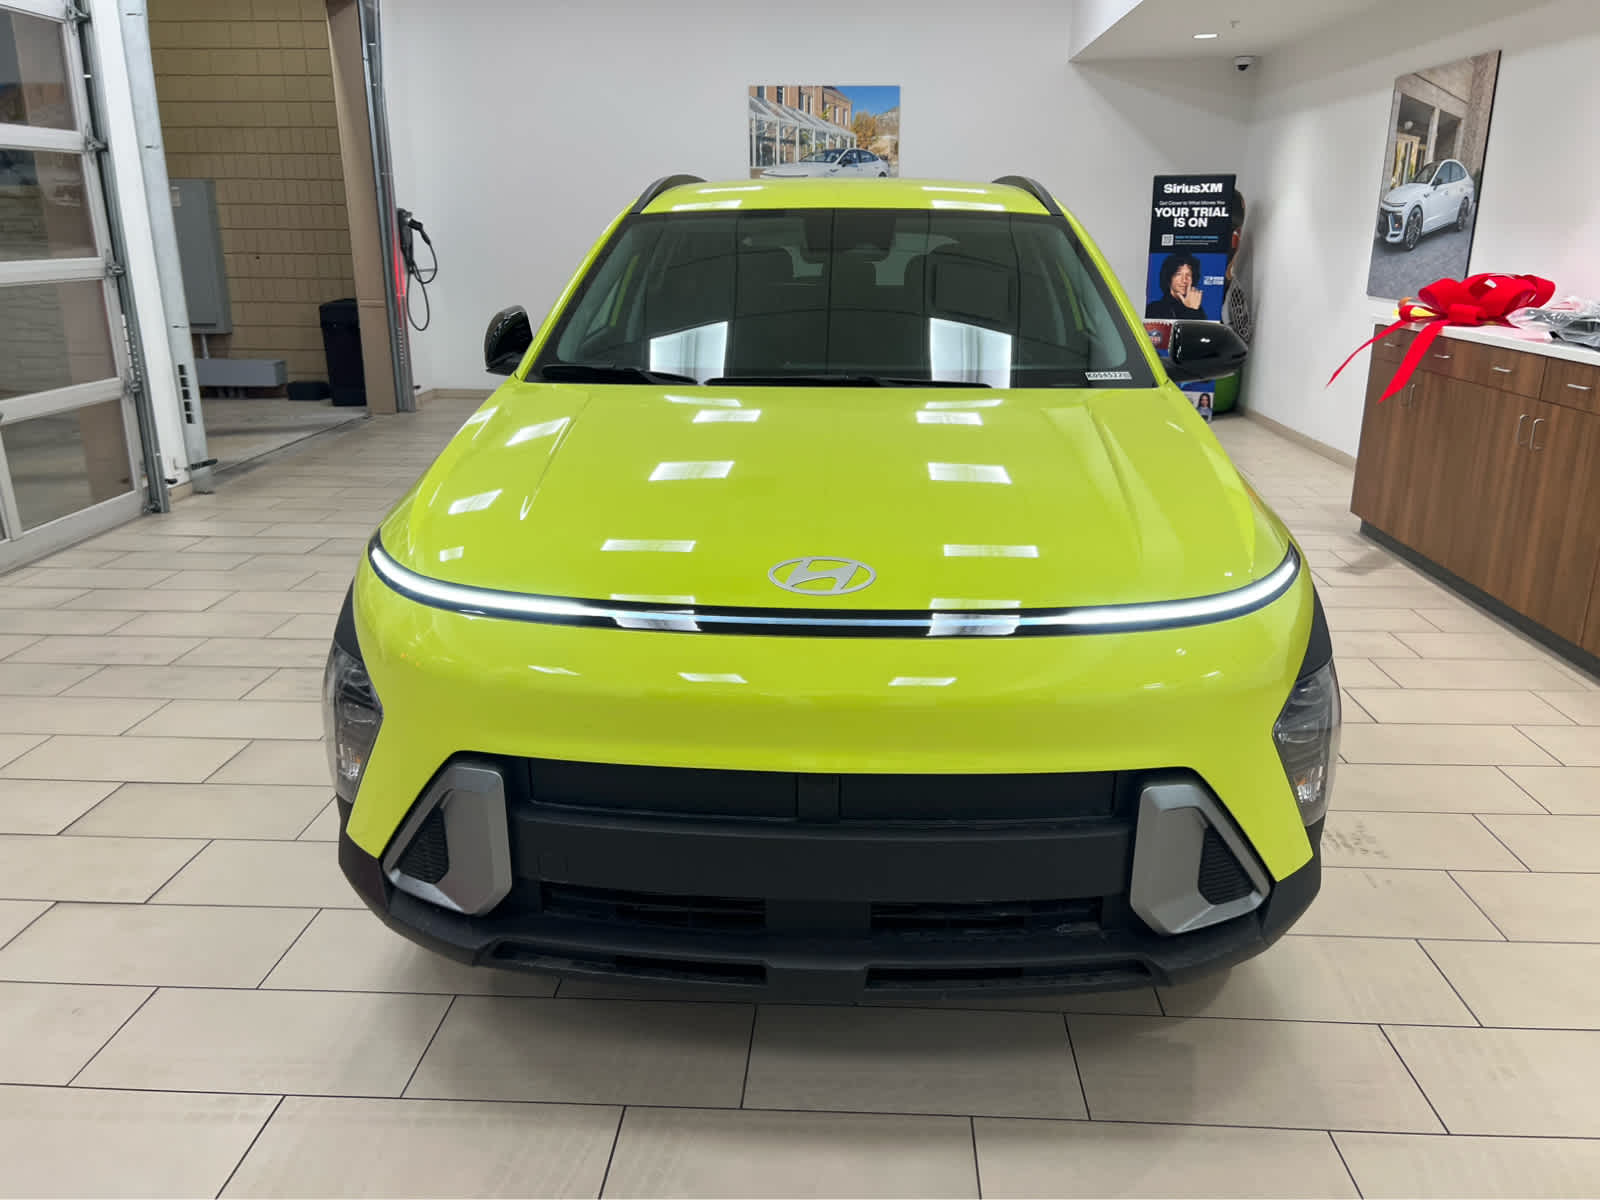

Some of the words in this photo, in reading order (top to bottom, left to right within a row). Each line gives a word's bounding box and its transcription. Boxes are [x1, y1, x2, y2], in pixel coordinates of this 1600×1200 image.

[1163, 182, 1223, 194] SiriusXM
[1154, 207, 1189, 218] YOUR
[1192, 207, 1229, 217] TRIAL
[1173, 218, 1186, 228] IS
[1188, 217, 1208, 228] ON
